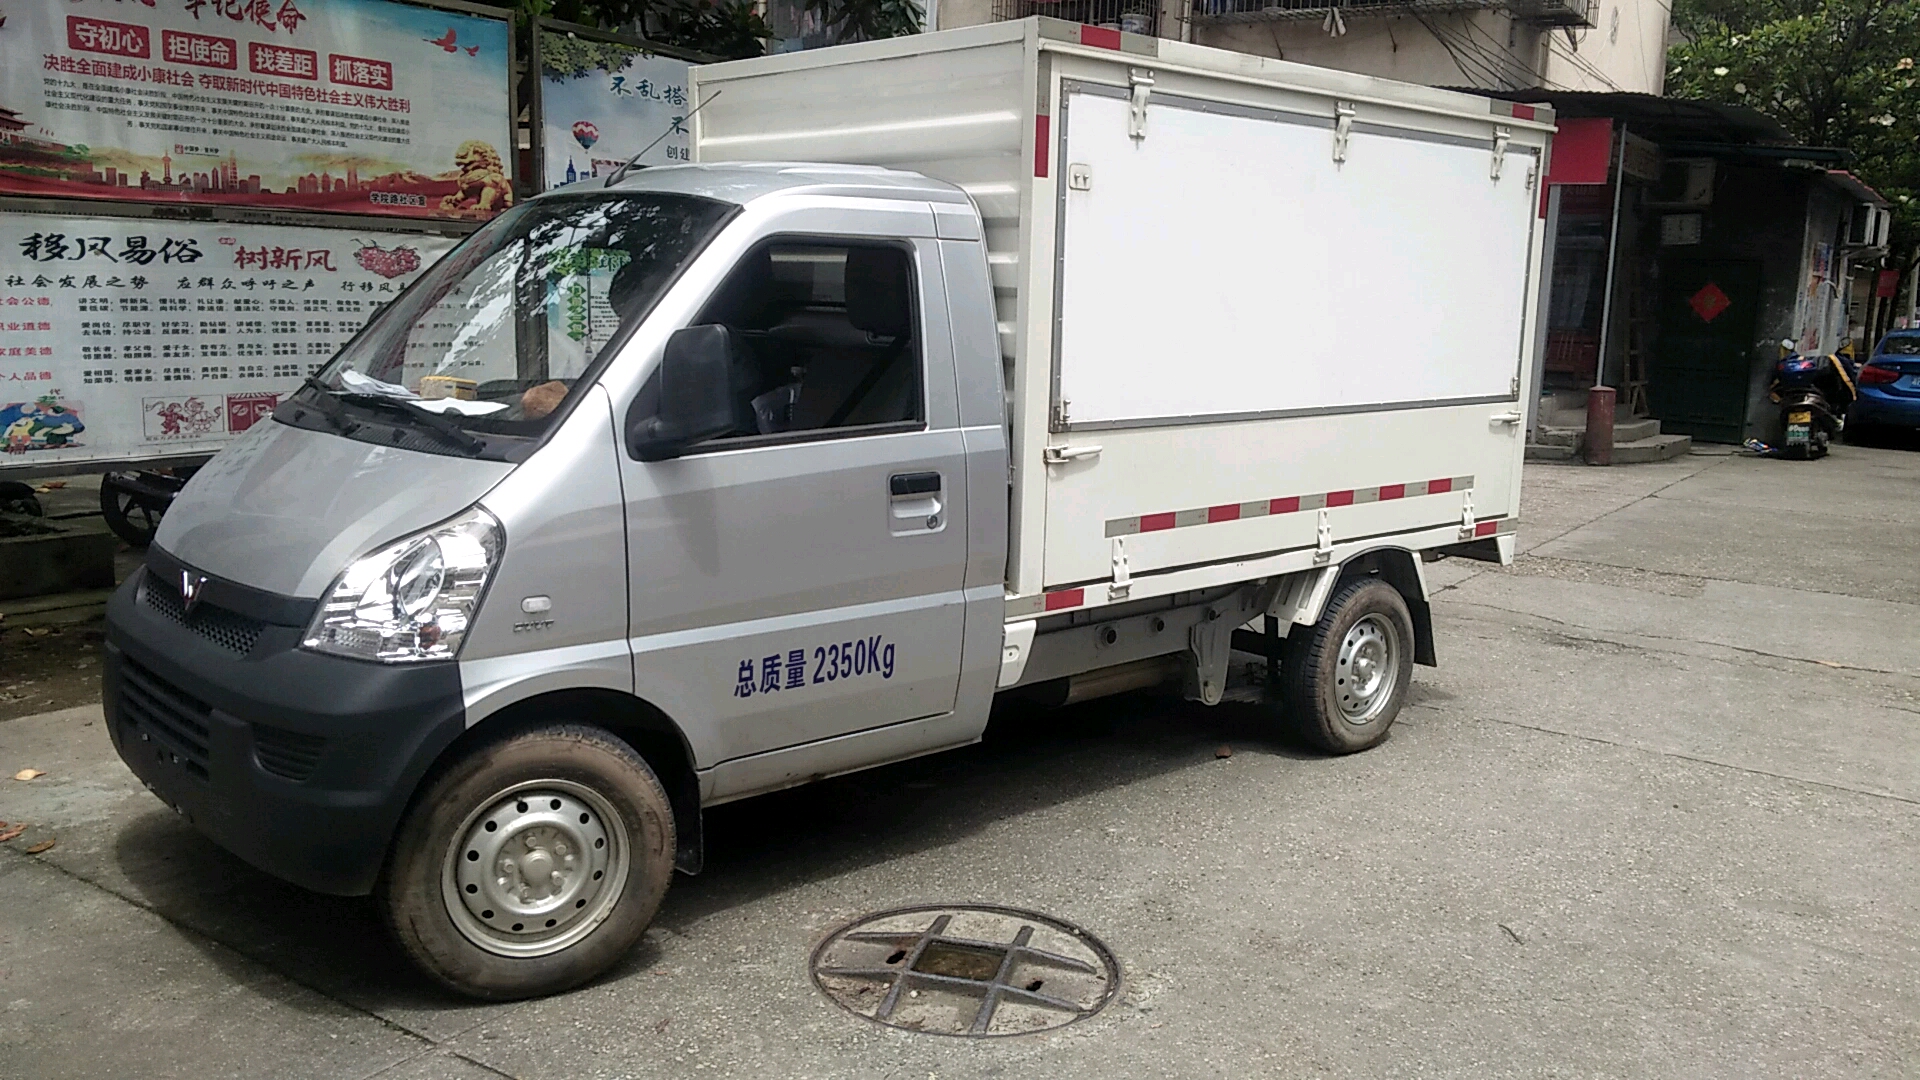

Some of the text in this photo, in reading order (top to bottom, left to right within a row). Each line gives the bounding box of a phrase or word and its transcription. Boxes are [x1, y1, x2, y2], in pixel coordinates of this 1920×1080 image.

[75, 22, 143, 53] 守初心
[168, 36, 230, 64] 担使命
[255, 47, 313, 76] 找差距
[334, 59, 388, 86] 抓落实
[43, 54, 410, 113] 决胜全面建成小康社会 夺取新时代中国特色社会主义伟大胜利
[610, 76, 688, 105] 不乱搭
[669, 116, 689, 134] 不
[371, 192, 426, 207] 学院路社区宣
[19, 232, 203, 265] 移风易俗
[234, 245, 337, 271] 树新风
[5, 274, 149, 289] 社会发展之势
[177, 277, 315, 291] 应群众呼吁之声
[0, 297, 50, 306] 会公德
[733, 635, 895, 698] 总质量2350Kg
